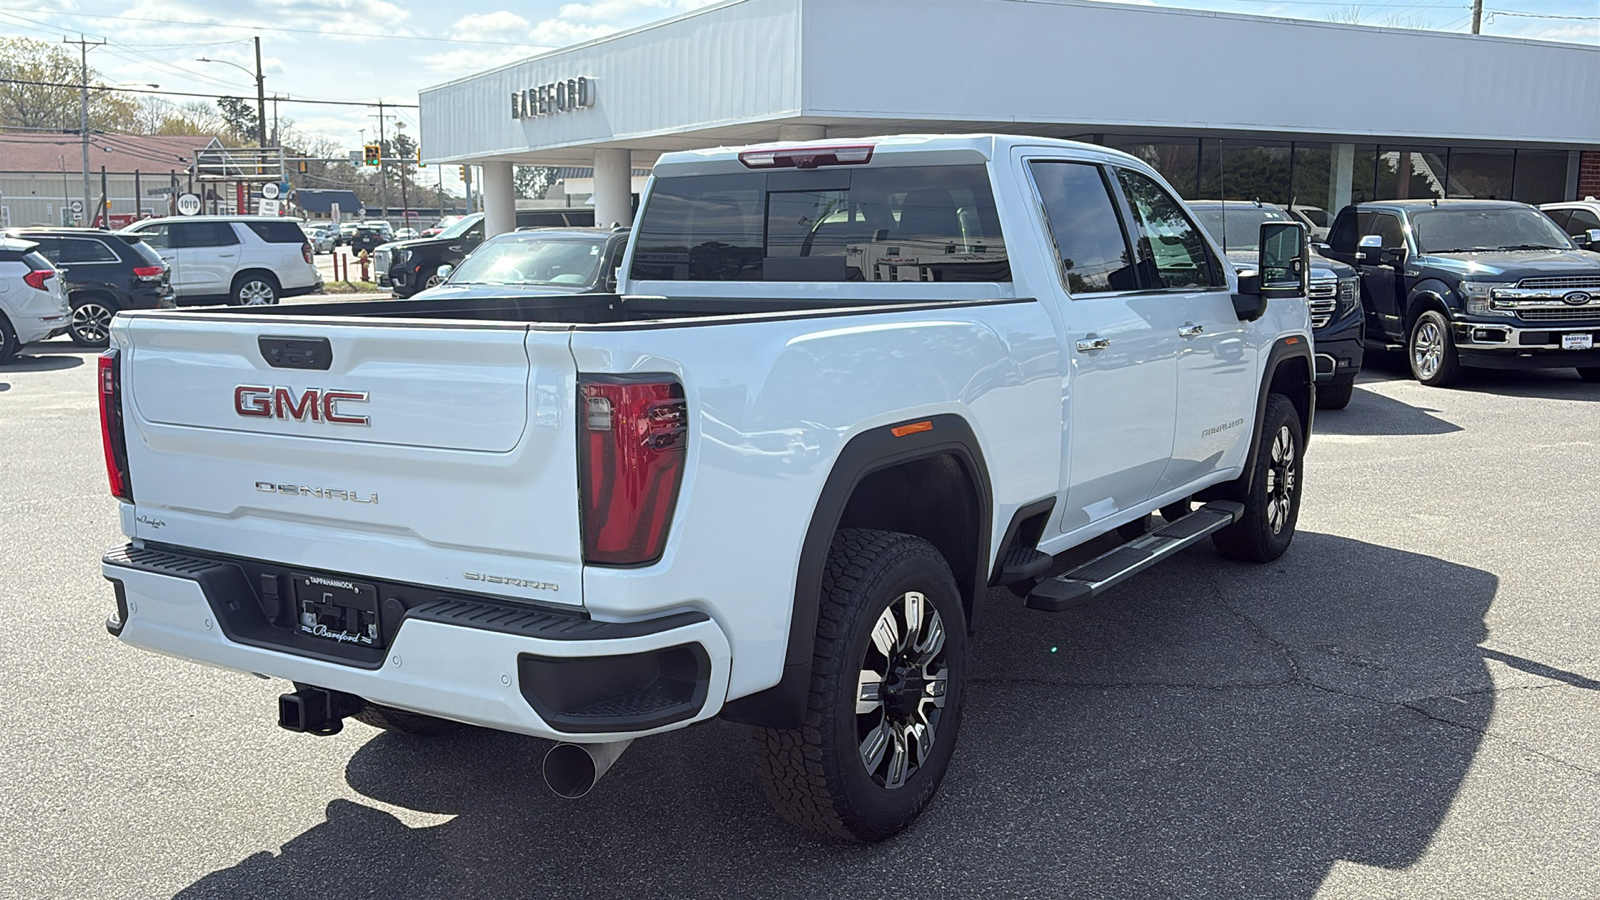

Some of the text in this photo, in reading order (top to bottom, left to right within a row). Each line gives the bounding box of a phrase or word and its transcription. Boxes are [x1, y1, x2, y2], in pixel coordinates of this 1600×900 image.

[511, 76, 592, 119] BAREFORD
[180, 199, 198, 210] 1010
[234, 383, 371, 427] GMC
[255, 481, 379, 504] DENALI
[309, 576, 354, 590] TAPPAHANNOCK
[463, 571, 559, 592] SIERRA
[313, 624, 361, 643] Bareford
